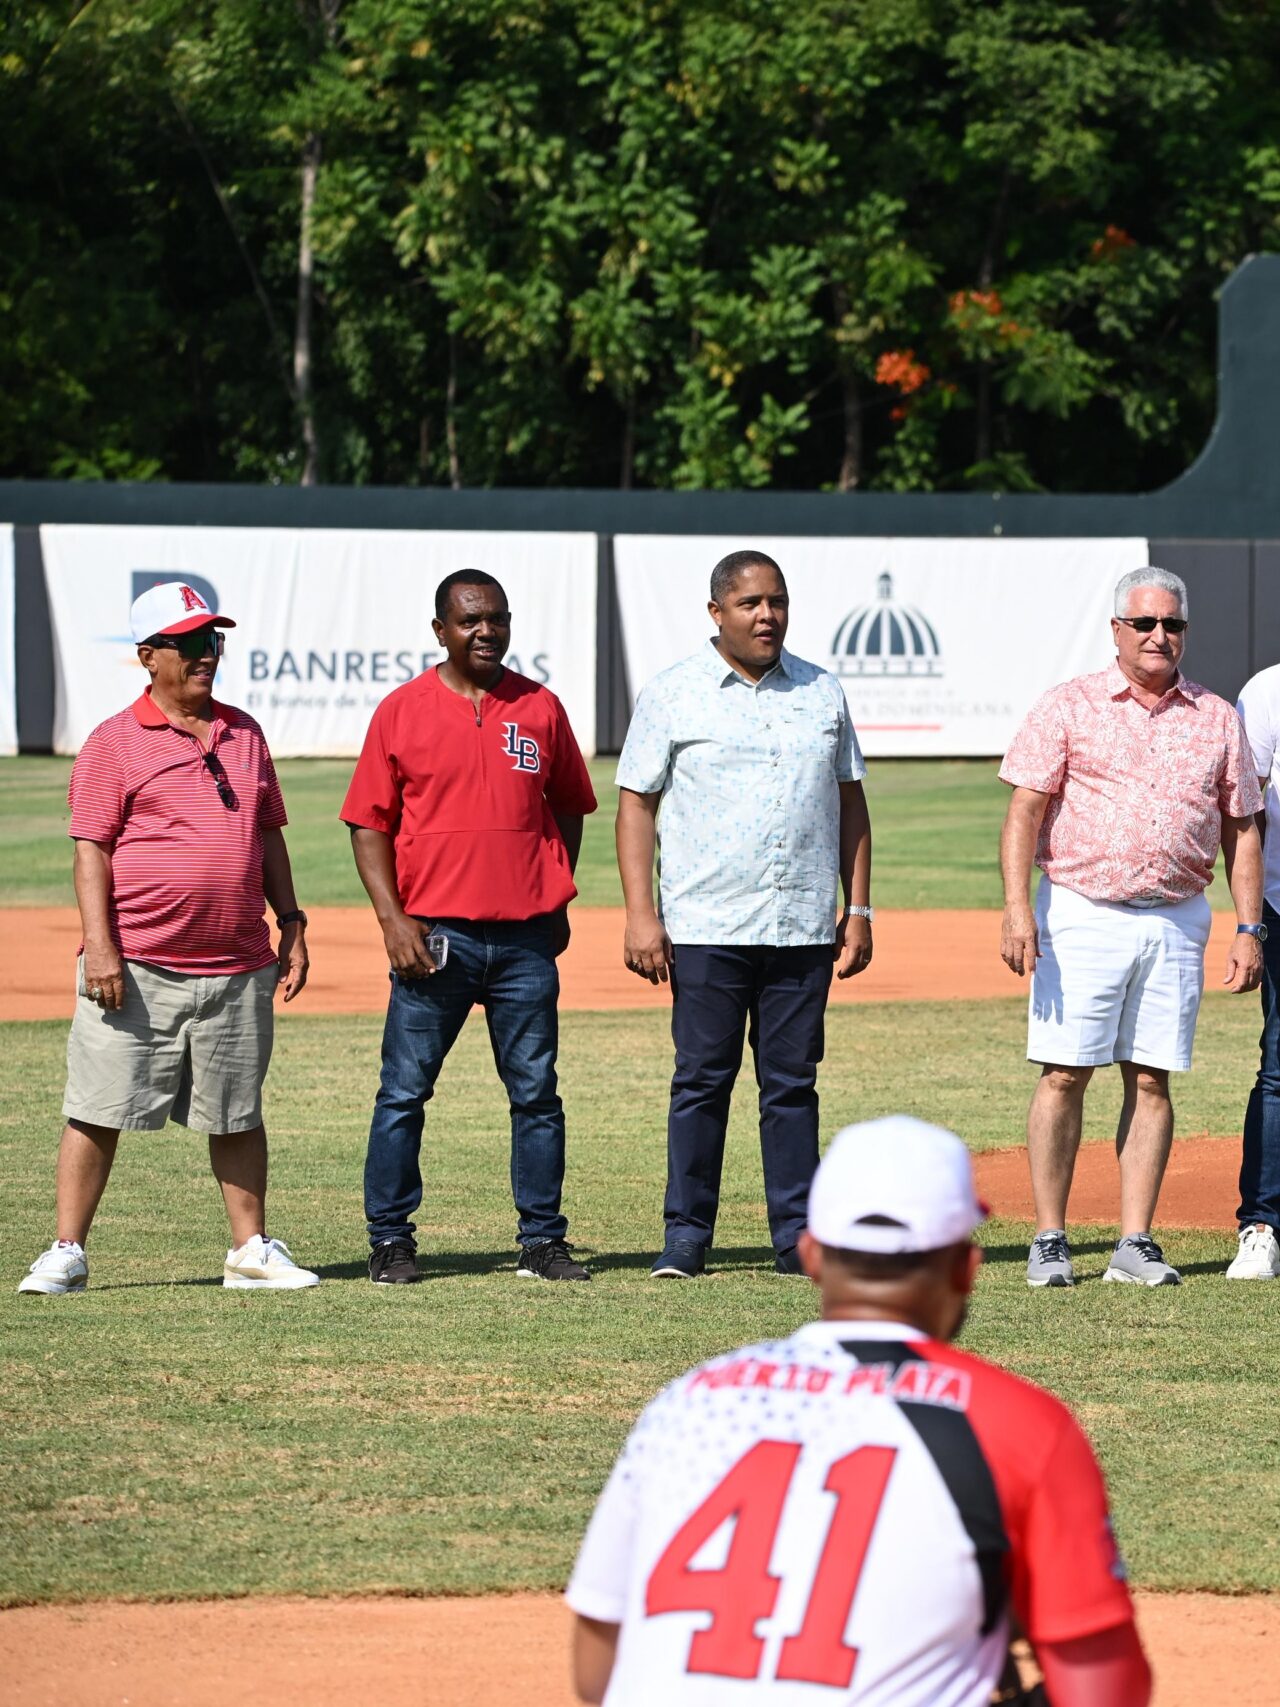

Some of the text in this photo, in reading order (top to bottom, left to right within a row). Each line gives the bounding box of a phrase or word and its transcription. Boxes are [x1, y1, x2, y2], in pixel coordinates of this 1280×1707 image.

[179, 585, 207, 612] A
[249, 651, 551, 684] BANRESEAS
[501, 721, 540, 773] LB
[842, 1361, 971, 1411] PLATA
[645, 1438, 898, 1688] 41
